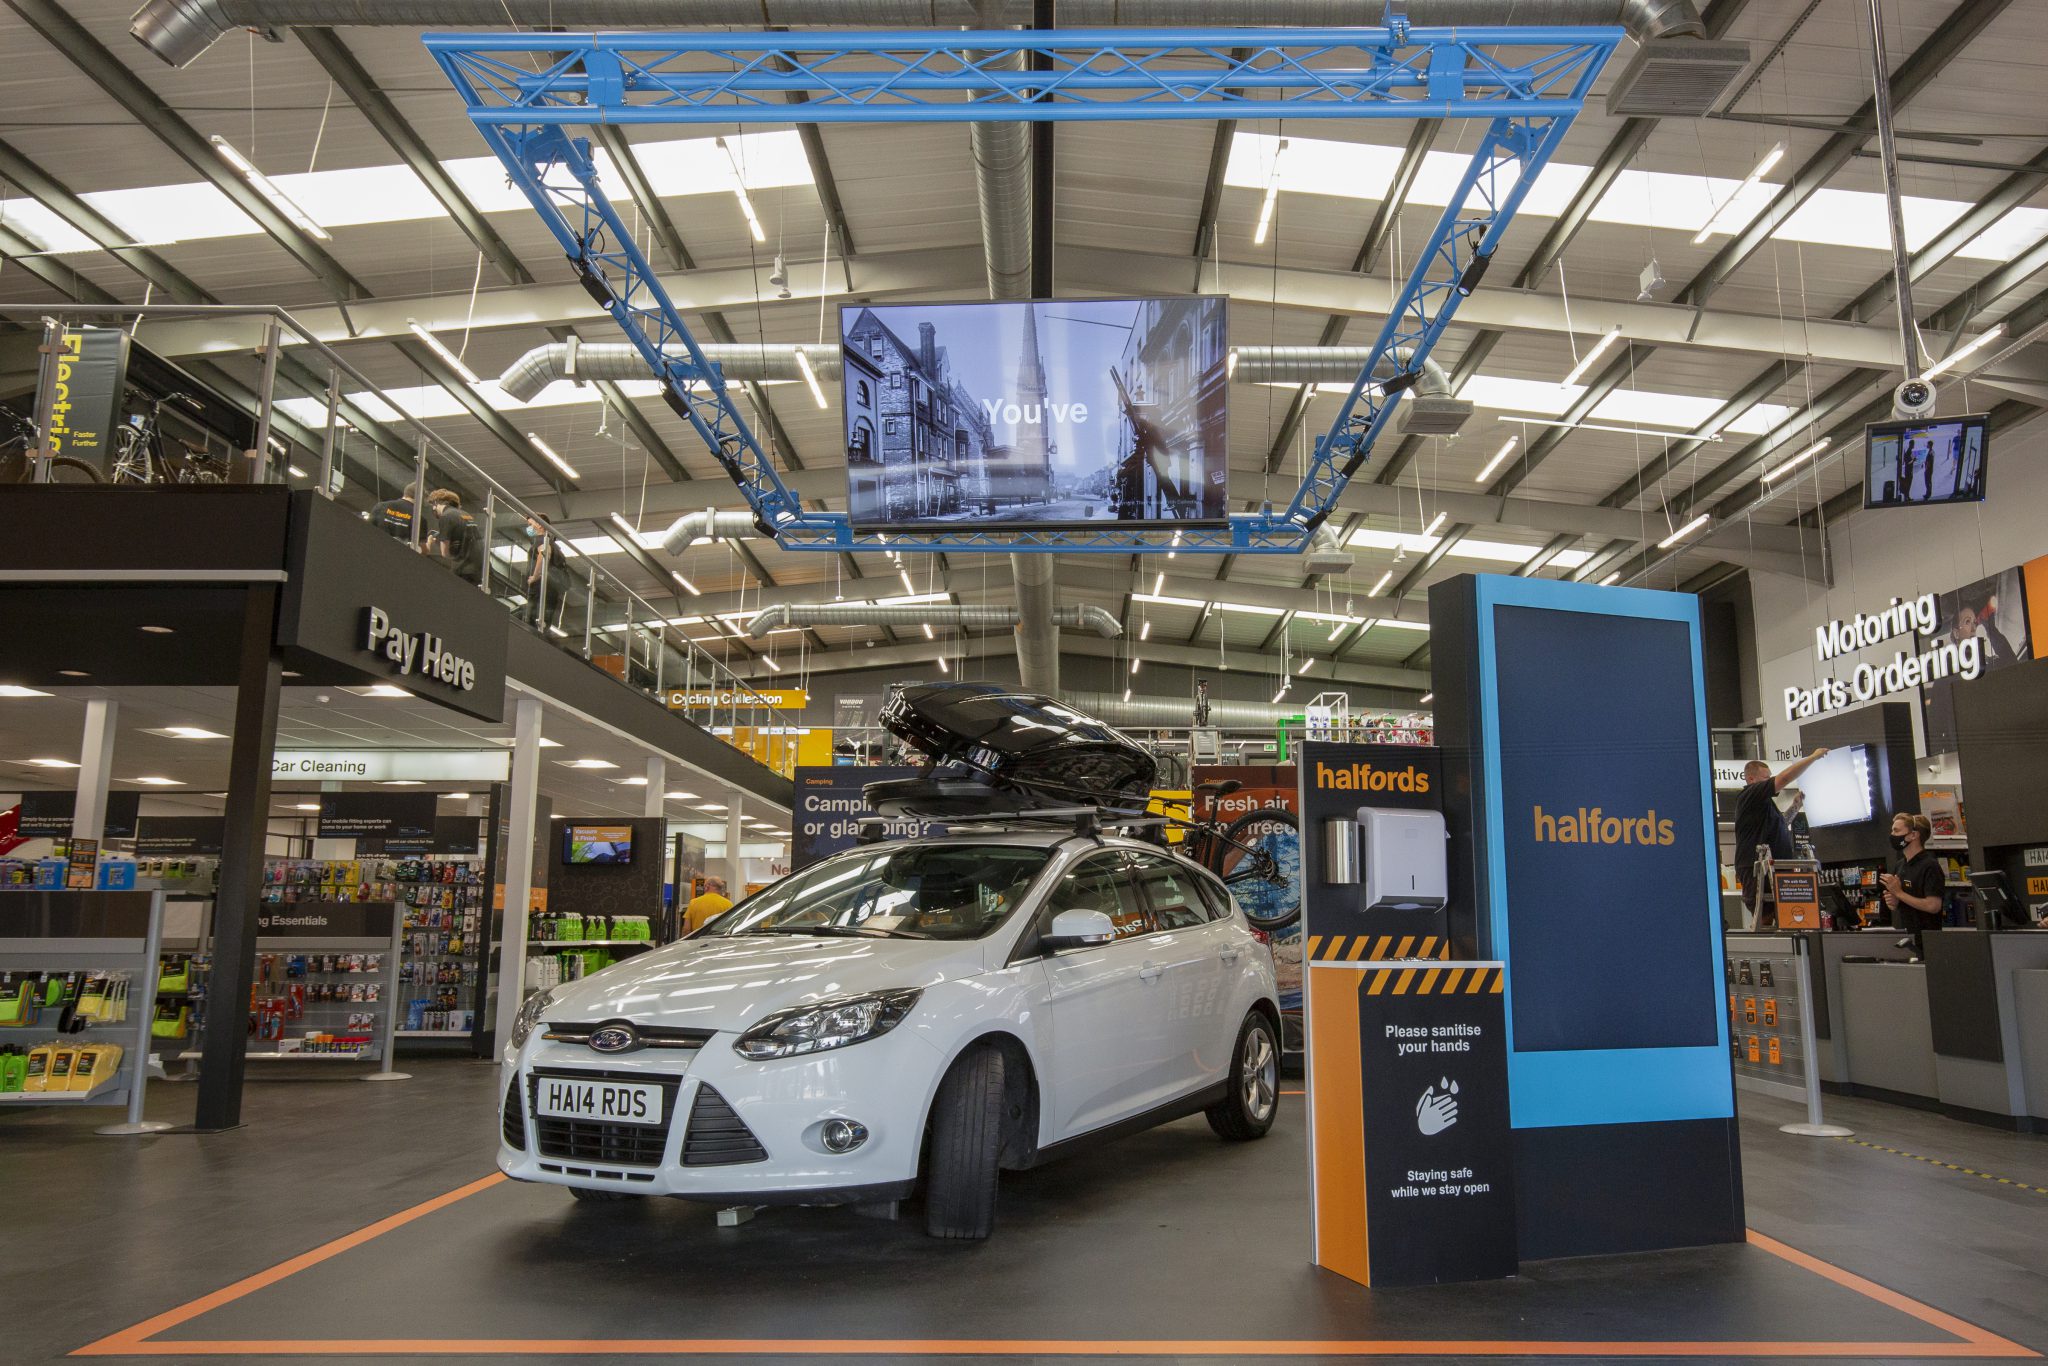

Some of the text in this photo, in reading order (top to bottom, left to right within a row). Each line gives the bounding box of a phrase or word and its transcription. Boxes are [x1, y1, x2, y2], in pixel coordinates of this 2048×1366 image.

[49, 334, 82, 452] Electric
[982, 397, 1088, 426] You've
[73, 430, 96, 439] Faster
[72, 439, 98, 447] Further
[1816, 593, 1938, 661] Motoring
[366, 606, 475, 691] Pay Here
[1784, 637, 1982, 721] Parts Ordering
[672, 692, 783, 706] Cycling Collection
[1775, 748, 1790, 761] The
[272, 759, 366, 775] Car Cleaning
[805, 778, 833, 786] Camping
[1317, 762, 1429, 793] halfords
[1205, 795, 1290, 812] Fresh air
[804, 822, 825, 835] or
[1534, 805, 1675, 846] halfords
[271, 915, 328, 926] Essentials
[1385, 1023, 1482, 1037] Please sanitise
[1398, 1040, 1470, 1056] your hands
[549, 1083, 647, 1118] HA14 RDS
[1407, 1167, 1473, 1183] Staying safe
[1391, 1183, 1490, 1198] while we stay open
